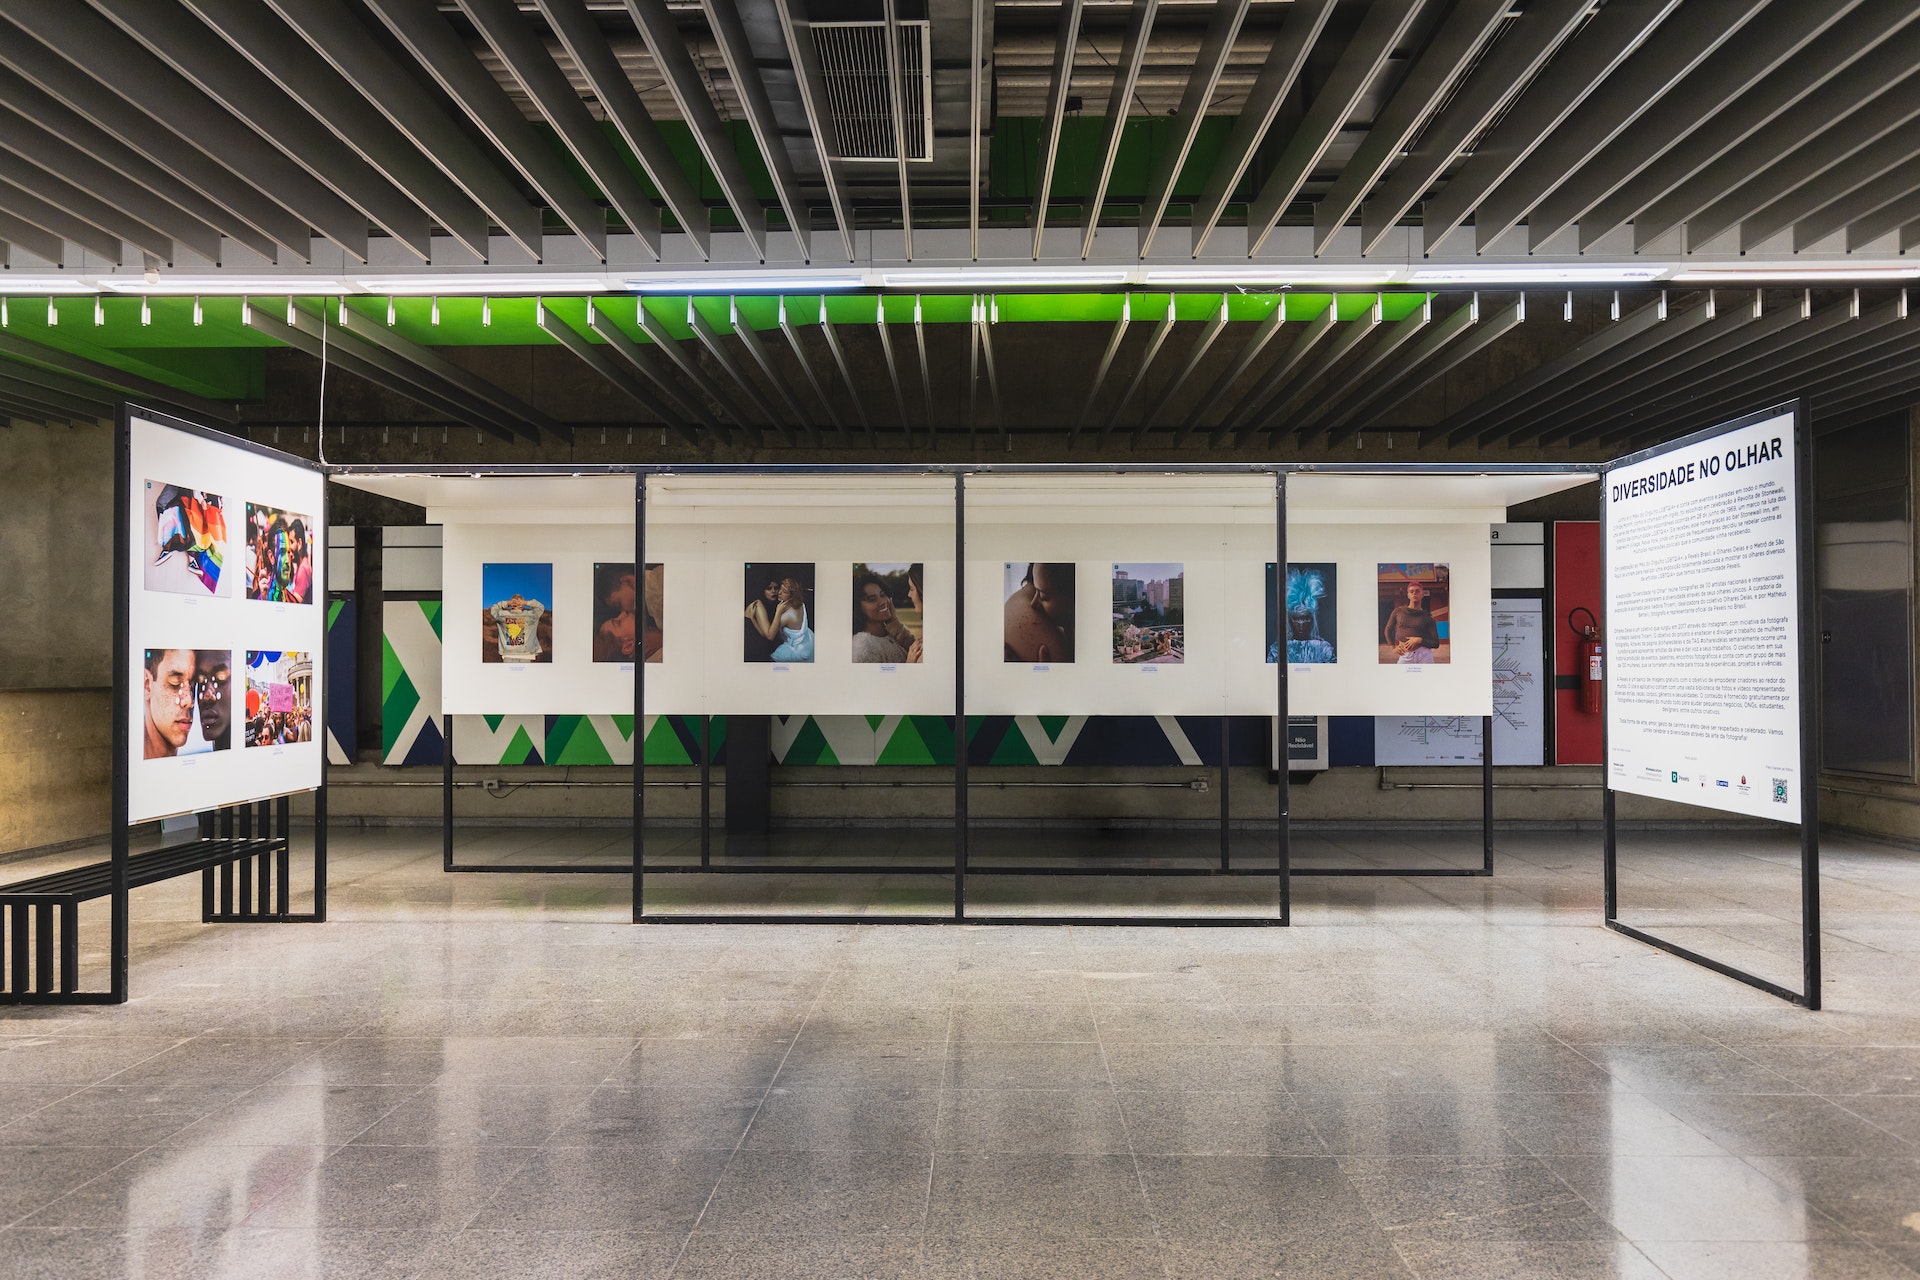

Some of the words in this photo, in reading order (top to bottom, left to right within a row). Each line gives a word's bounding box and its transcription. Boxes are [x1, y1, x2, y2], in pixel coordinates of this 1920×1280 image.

[1612, 462, 1694, 502] DIVERSIDADE
[1700, 456, 1720, 479] NO
[1726, 438, 1782, 472] OLHAR
